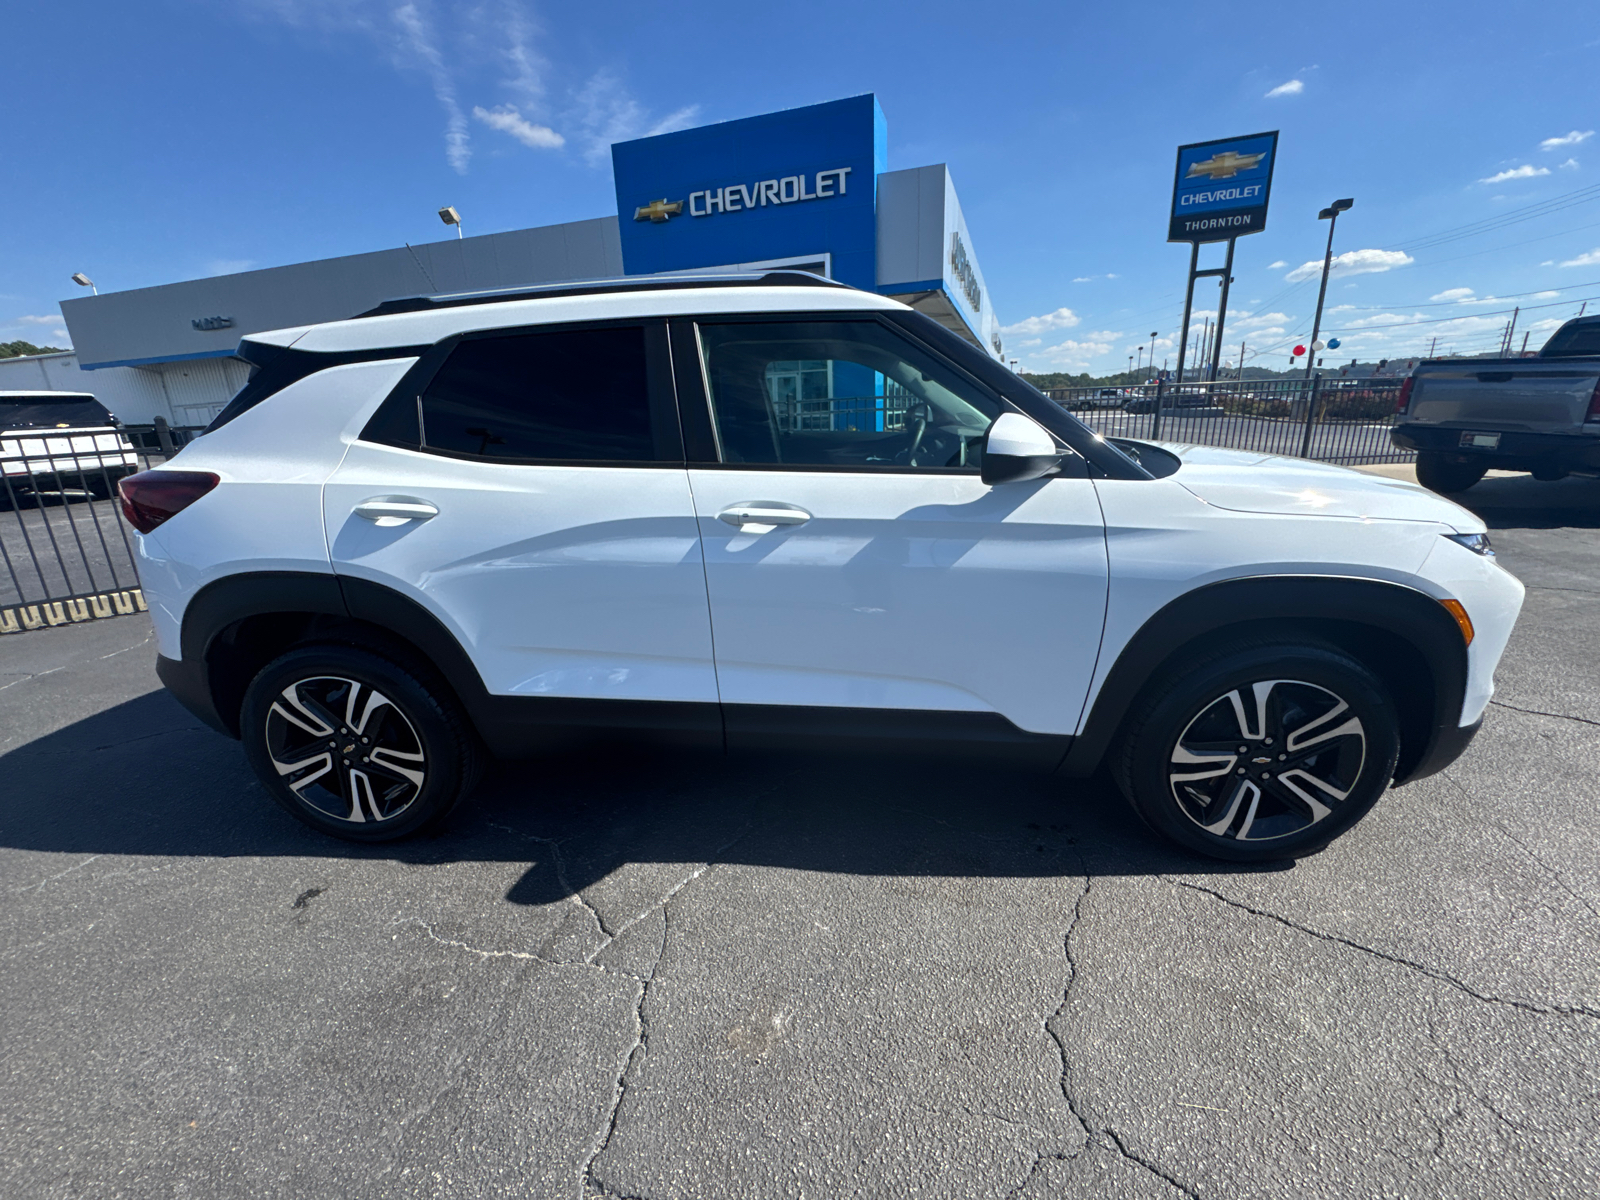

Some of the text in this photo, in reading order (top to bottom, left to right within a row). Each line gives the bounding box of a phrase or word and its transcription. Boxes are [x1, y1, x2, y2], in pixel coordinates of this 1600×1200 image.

[689, 167, 851, 216] CHEVROLET
[1181, 185, 1261, 205] CHEVROLET
[1185, 215, 1251, 231] THORNTON
